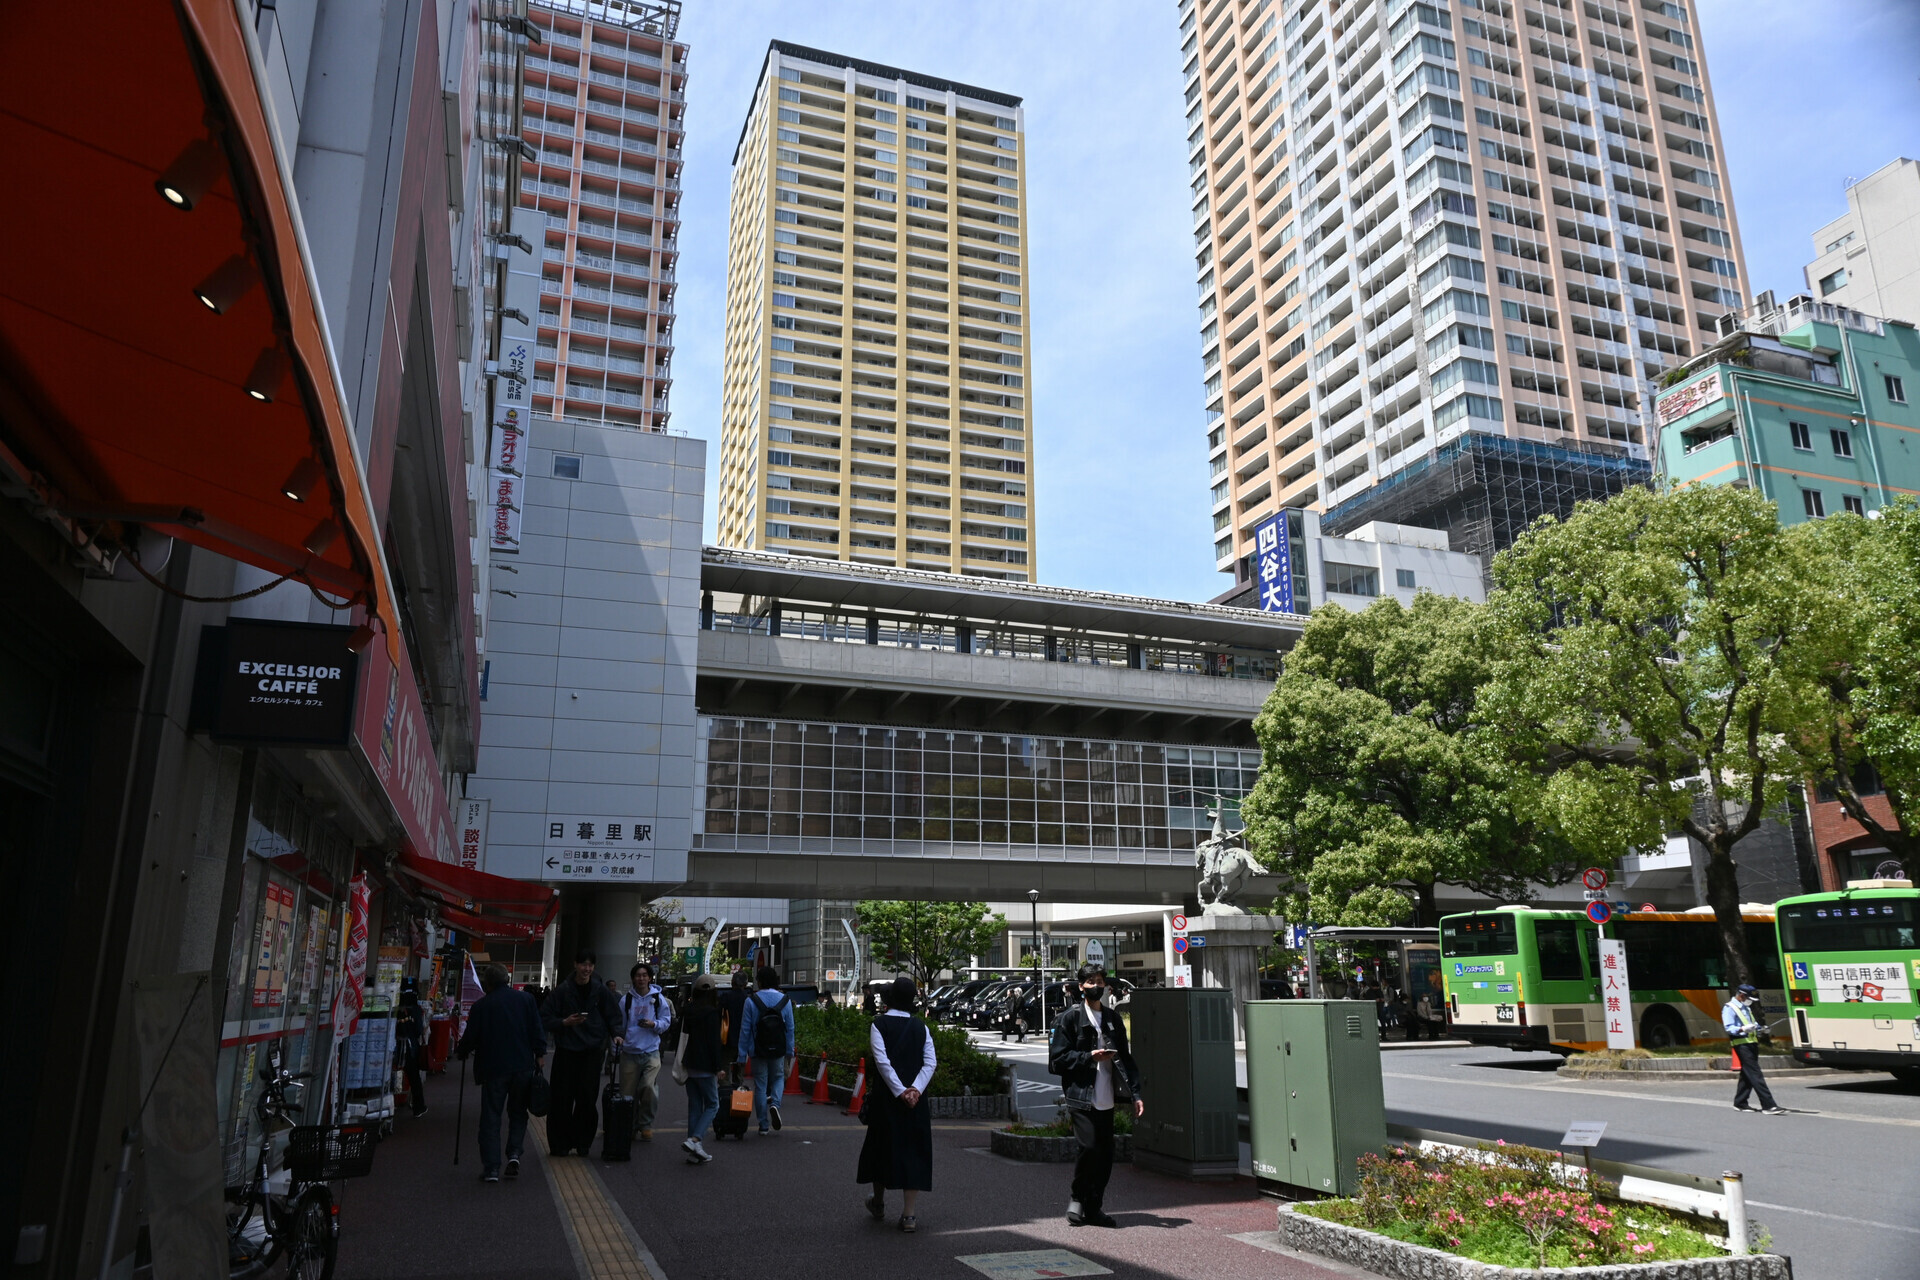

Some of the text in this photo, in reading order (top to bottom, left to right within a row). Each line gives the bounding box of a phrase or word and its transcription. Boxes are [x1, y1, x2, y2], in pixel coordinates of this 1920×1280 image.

[239, 661, 341, 680] EXCELSIOR
[258, 679, 318, 694] CAFFÉ
[249, 696, 301, 705] エクセルシオール
[550, 822, 651, 841] 日暮里駅
[574, 851, 651, 861] 日暮里・舎人ライナー
[573, 865, 593, 874] JR線
[610, 866, 635, 875] 京成線
[1820, 967, 1901, 981] 朝日信用金庫
[1603, 954, 1623, 1033] 進入禁止
